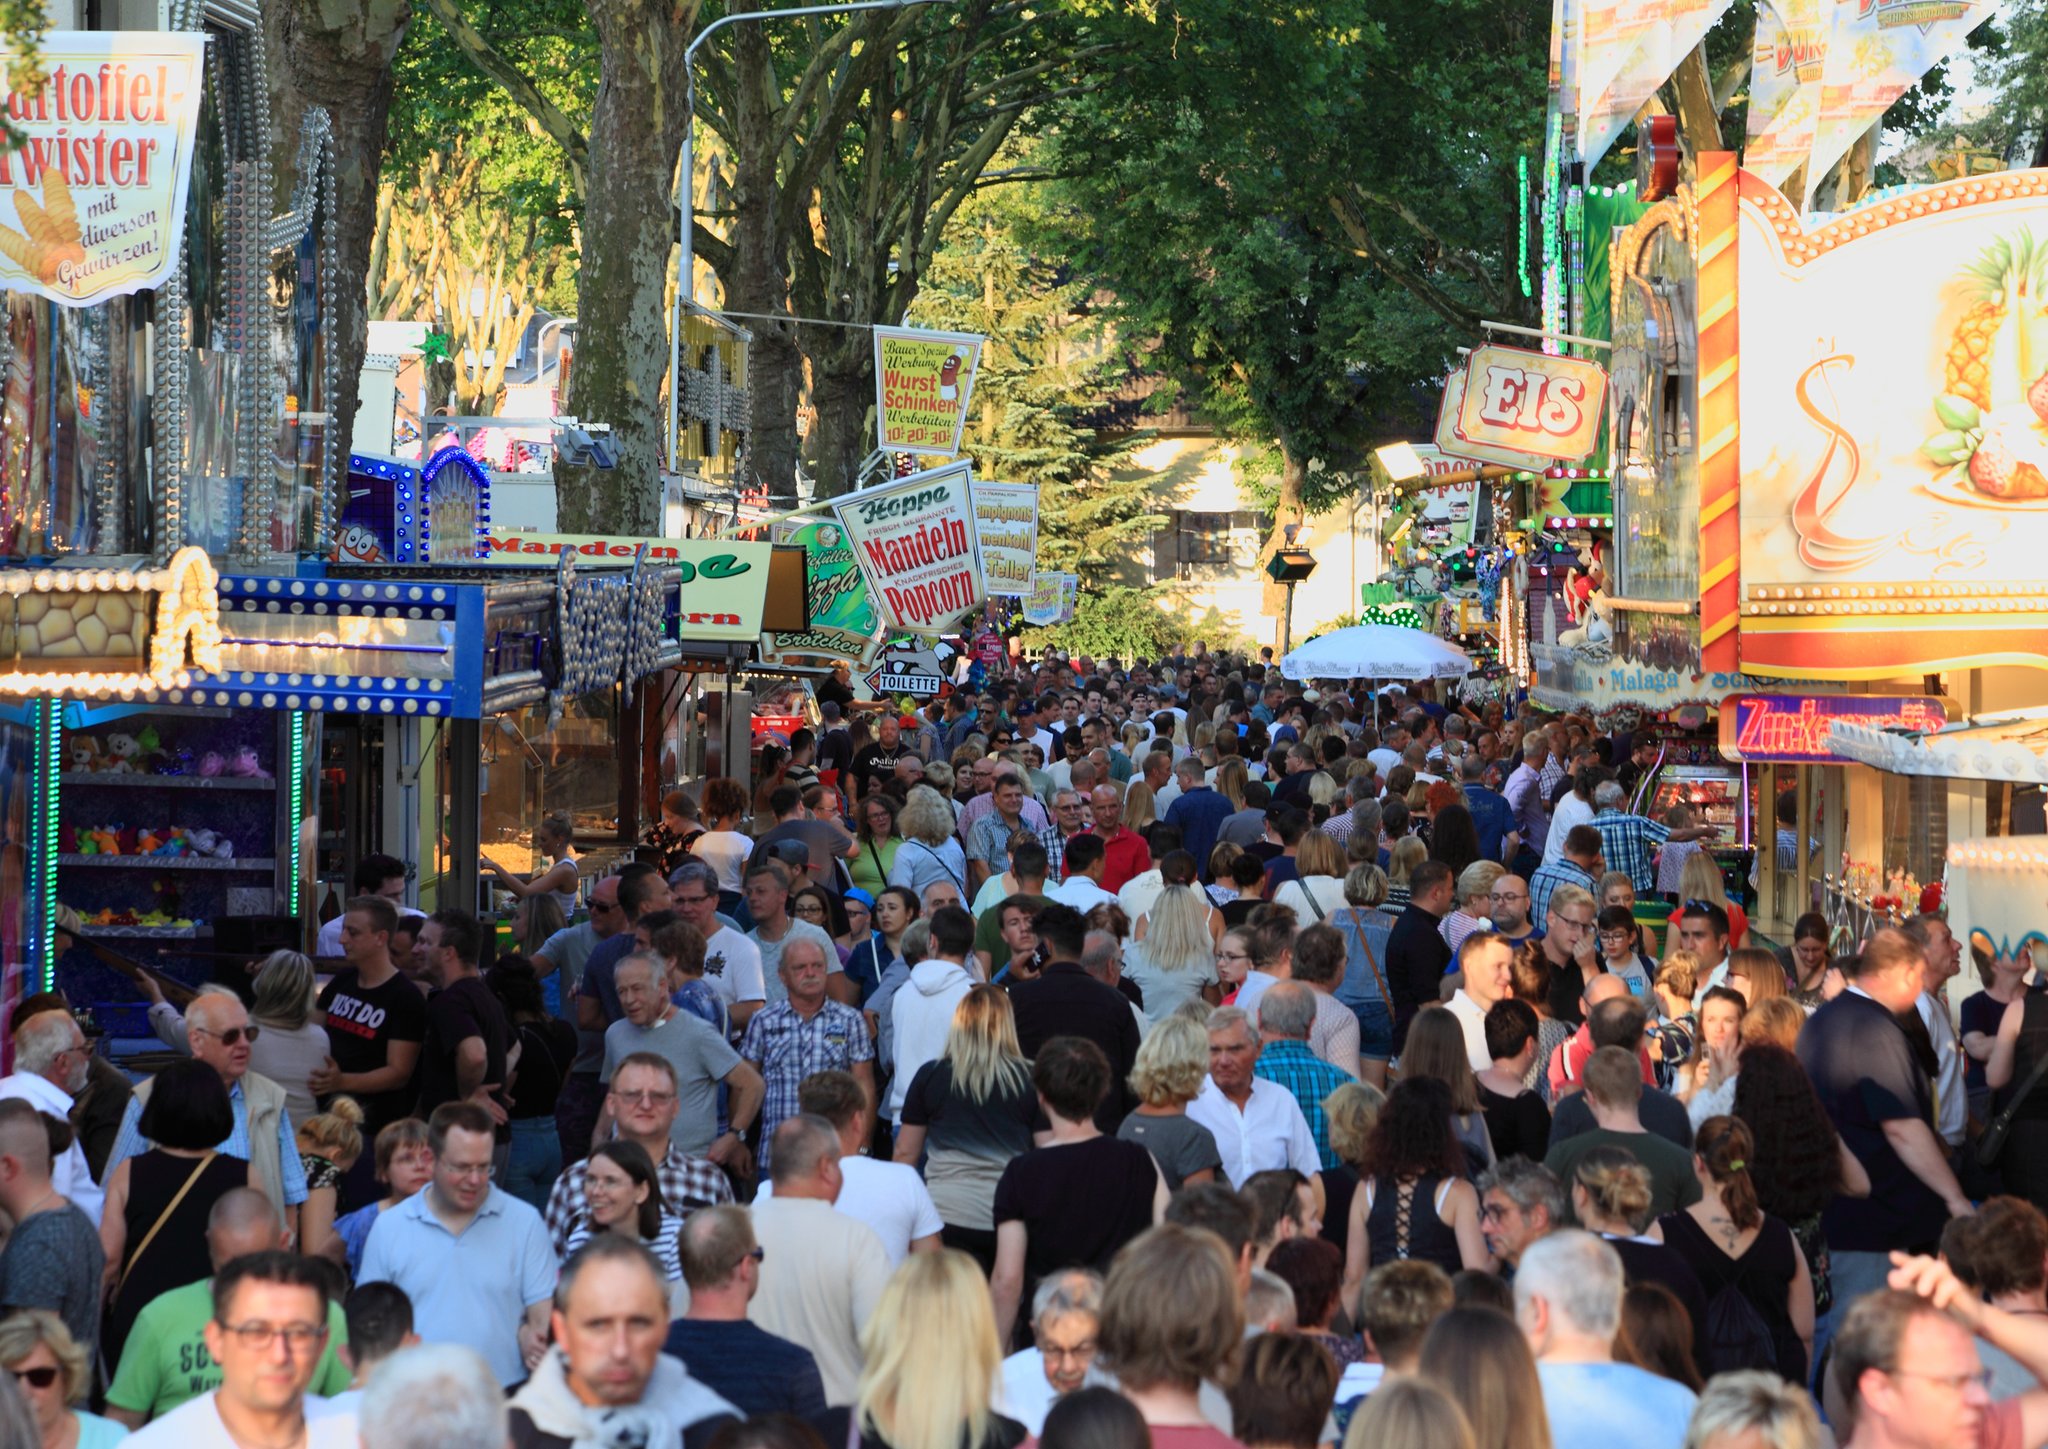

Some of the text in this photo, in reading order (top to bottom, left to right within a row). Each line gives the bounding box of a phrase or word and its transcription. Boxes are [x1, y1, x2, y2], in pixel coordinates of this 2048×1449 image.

[87, 192, 118, 219] mit
[81, 209, 157, 249] diversen
[56, 230, 159, 290] Gewürzen!
[885, 355, 937, 371] Werbung
[884, 369, 937, 393] Wurst
[884, 389, 957, 414] Schinken
[1480, 365, 1585, 437] EIS
[859, 485, 950, 525] Hoppe
[975, 503, 1034, 524] ampignons
[863, 517, 969, 579] Mandeln
[980, 527, 1033, 552] menkohl
[808, 564, 862, 620] izza
[883, 569, 976, 627] Popcorn
[882, 675, 937, 692] TOILETTE
[1610, 668, 1679, 693] Malaga
[328, 993, 362, 1020] JUST
[355, 1003, 386, 1029] DO
